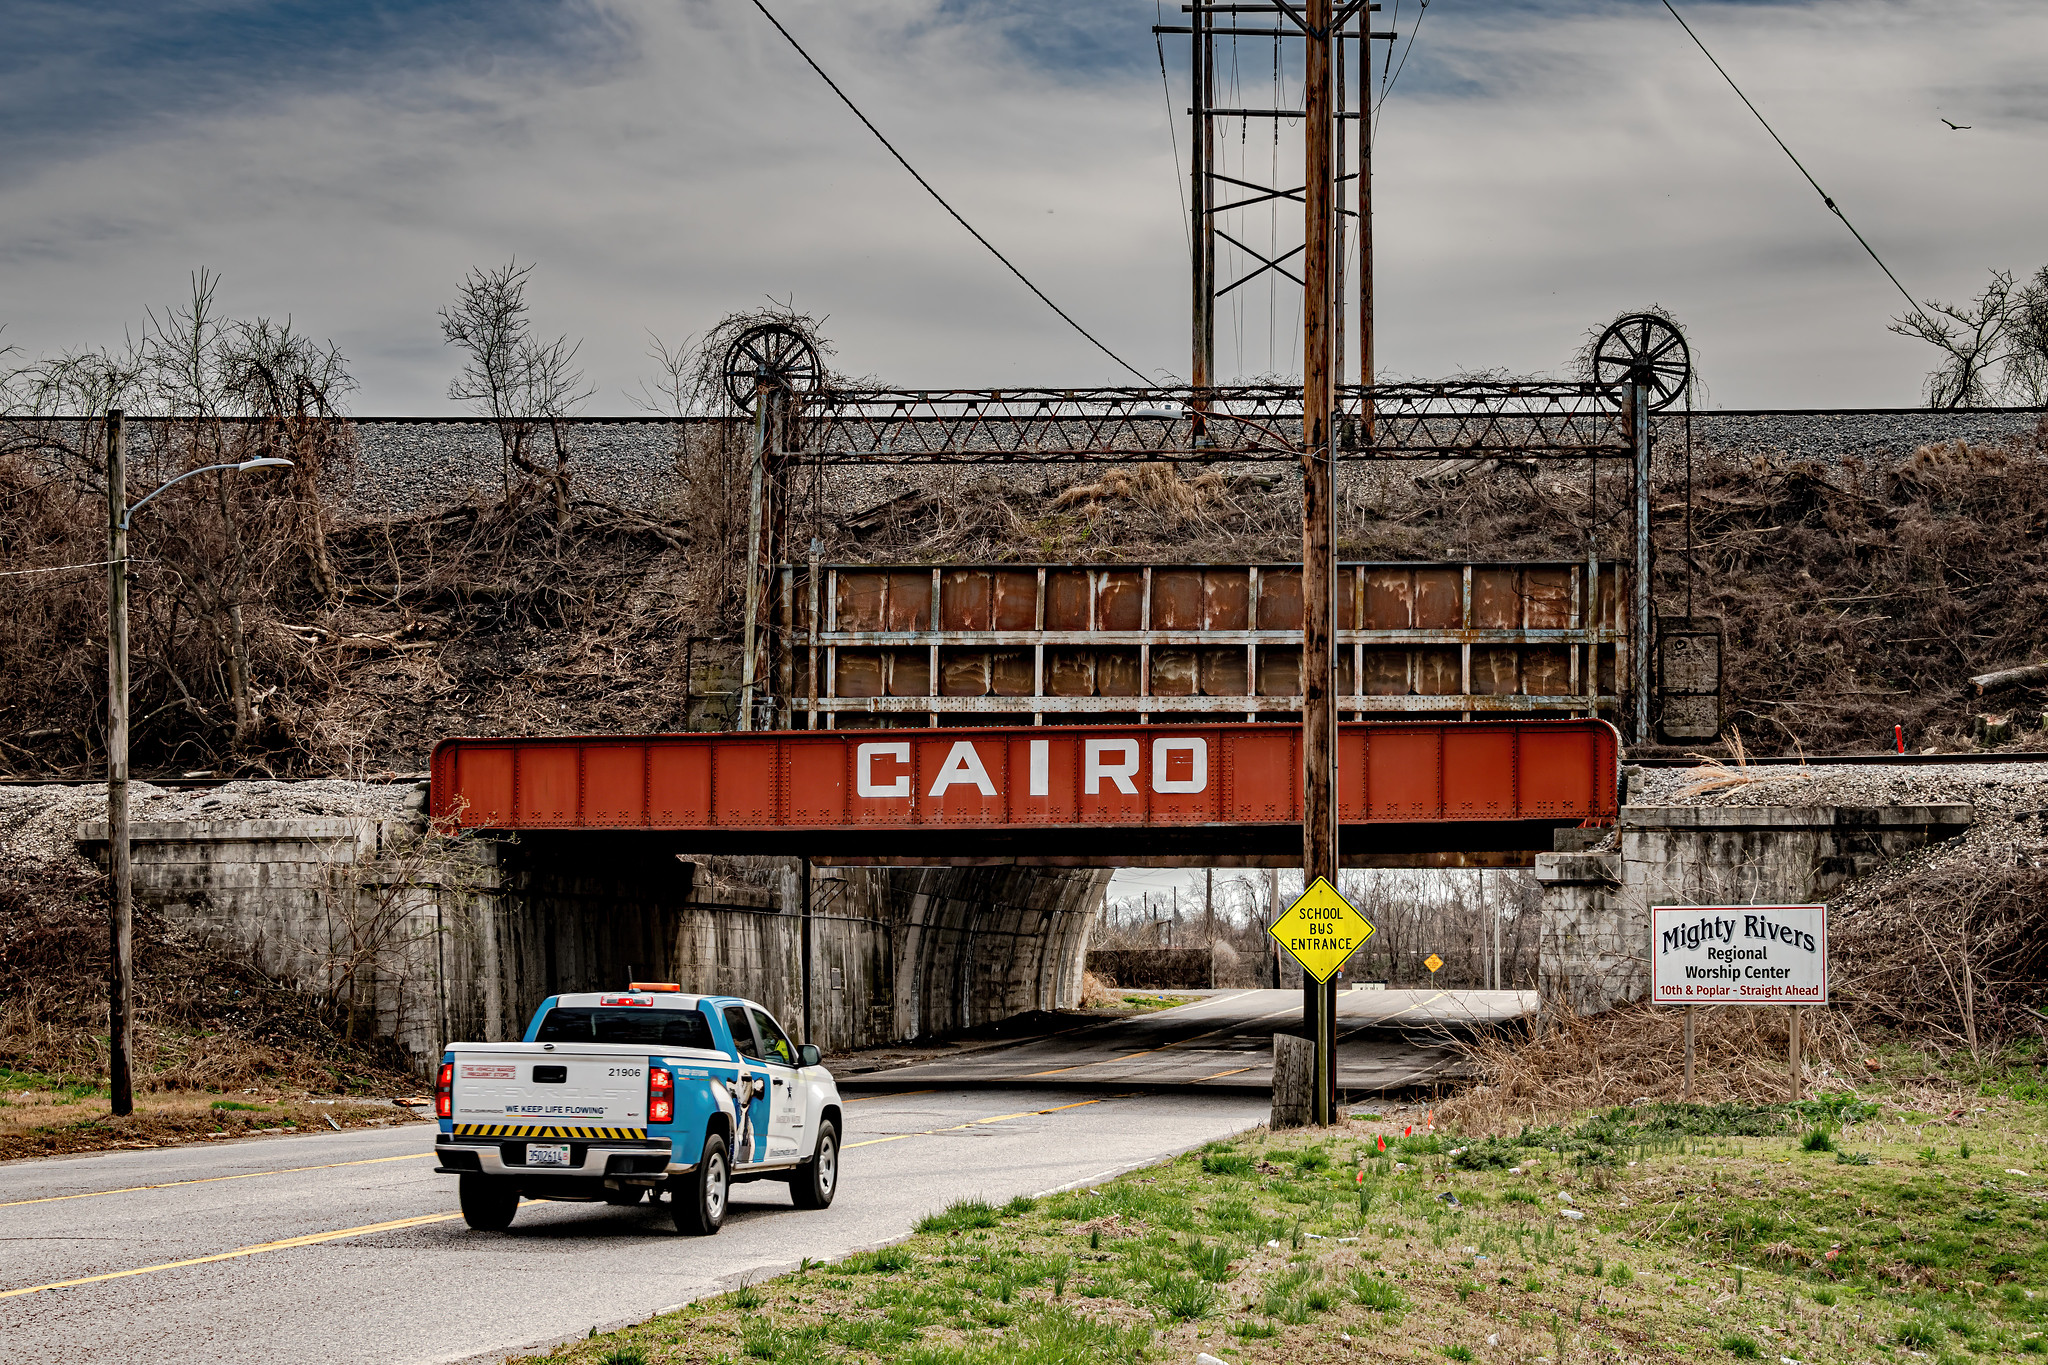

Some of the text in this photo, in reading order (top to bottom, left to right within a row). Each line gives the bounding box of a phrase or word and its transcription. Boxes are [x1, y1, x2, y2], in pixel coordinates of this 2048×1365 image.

[857, 737, 1207, 797] CAIRO
[1299, 907, 1343, 920] SCHOOL
[1309, 923, 1334, 935] BUS
[1662, 914, 1816, 955] Mighty Rivers
[1291, 938, 1352, 950] ENTRANCE
[1707, 945, 1768, 963] Regional
[1685, 964, 1790, 982] Worship Center
[1660, 985, 1683, 996] 10th
[1685, 985, 1694, 996] &
[1696, 985, 1731, 998] Poplar
[1740, 985, 1783, 998] Straight
[1785, 985, 1819, 996] Ahead
[608, 1068, 641, 1077] 21906
[461, 1085, 639, 1100] CHEVROLET
[505, 1105, 519, 1113] WE
[521, 1105, 544, 1113] KEEP
[545, 1106, 563, 1114] LIFE
